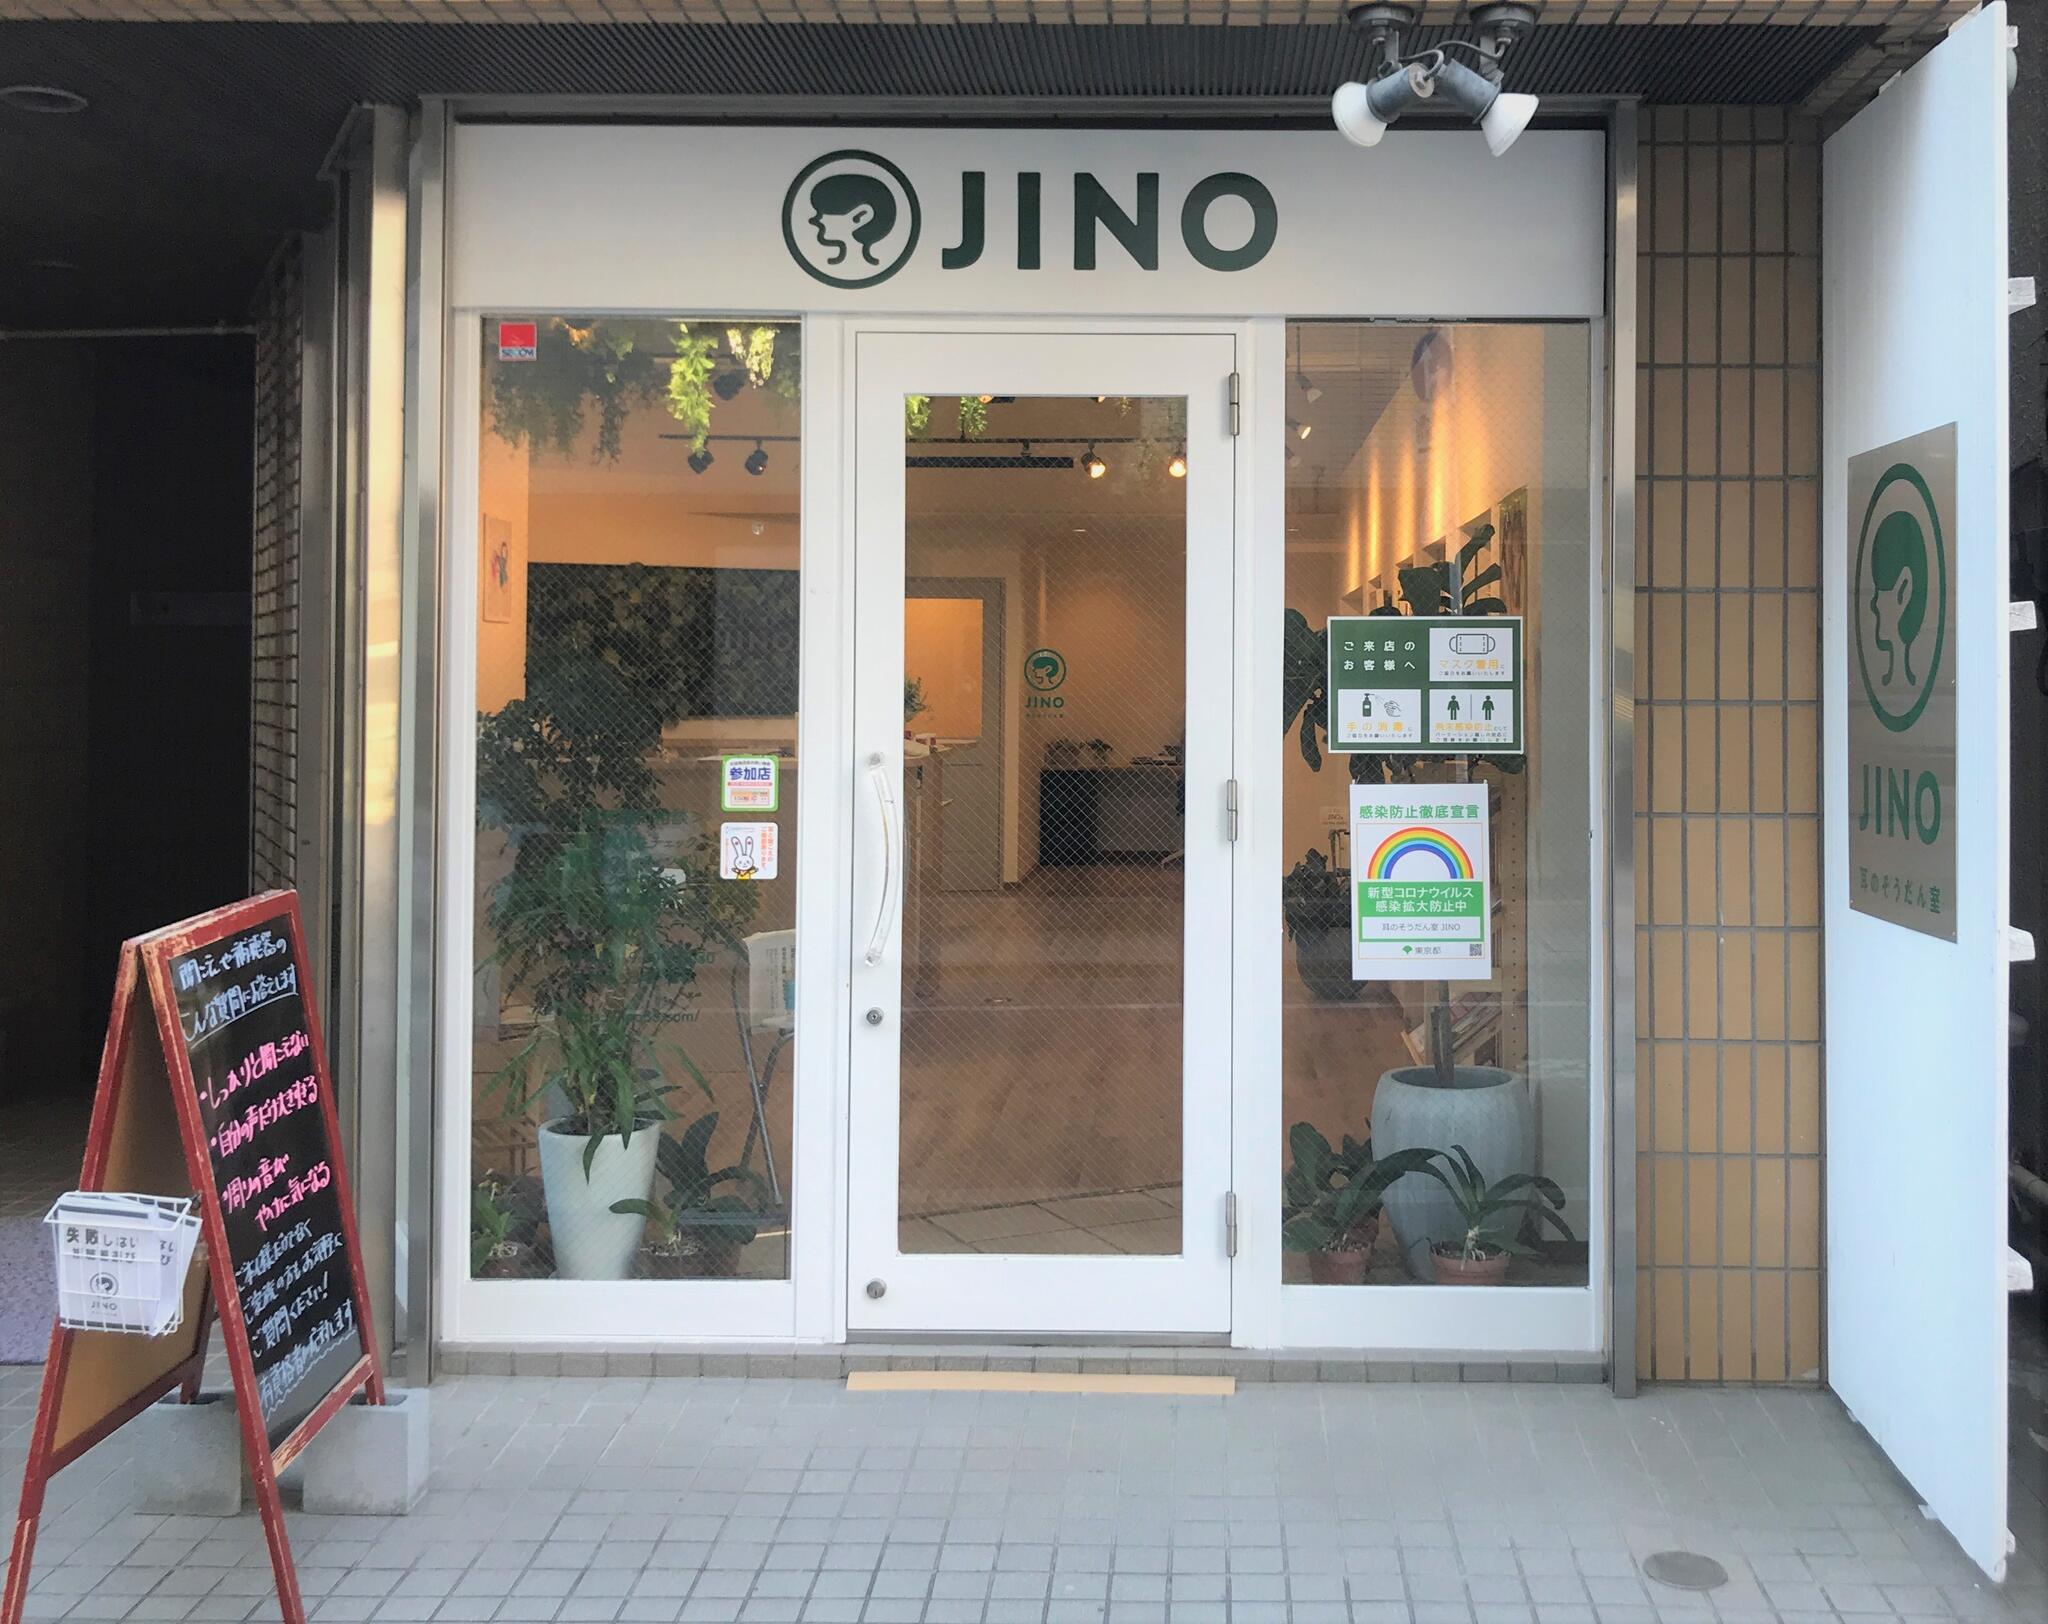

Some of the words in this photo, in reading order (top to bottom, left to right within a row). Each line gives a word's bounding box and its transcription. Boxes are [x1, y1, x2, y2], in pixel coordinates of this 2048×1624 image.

[942, 171, 1278, 272] JINO
[1343, 640, 1416, 652] ご来店の
[1343, 659, 1416, 671] お客様へ
[1024, 696, 1064, 709] JINO
[730, 767, 771, 781] 参加店
[1859, 764, 1941, 845] JINO
[1359, 804, 1480, 820] 感染防止徹底宣言
[1367, 886, 1474, 899] 新型コロナウイルス
[1859, 866, 1941, 914] 耳のそうだん室
[1375, 899, 1468, 913] 感染拡大防止中
[1440, 923, 1461, 931] JINO
[1415, 945, 1442, 955] 東京都
